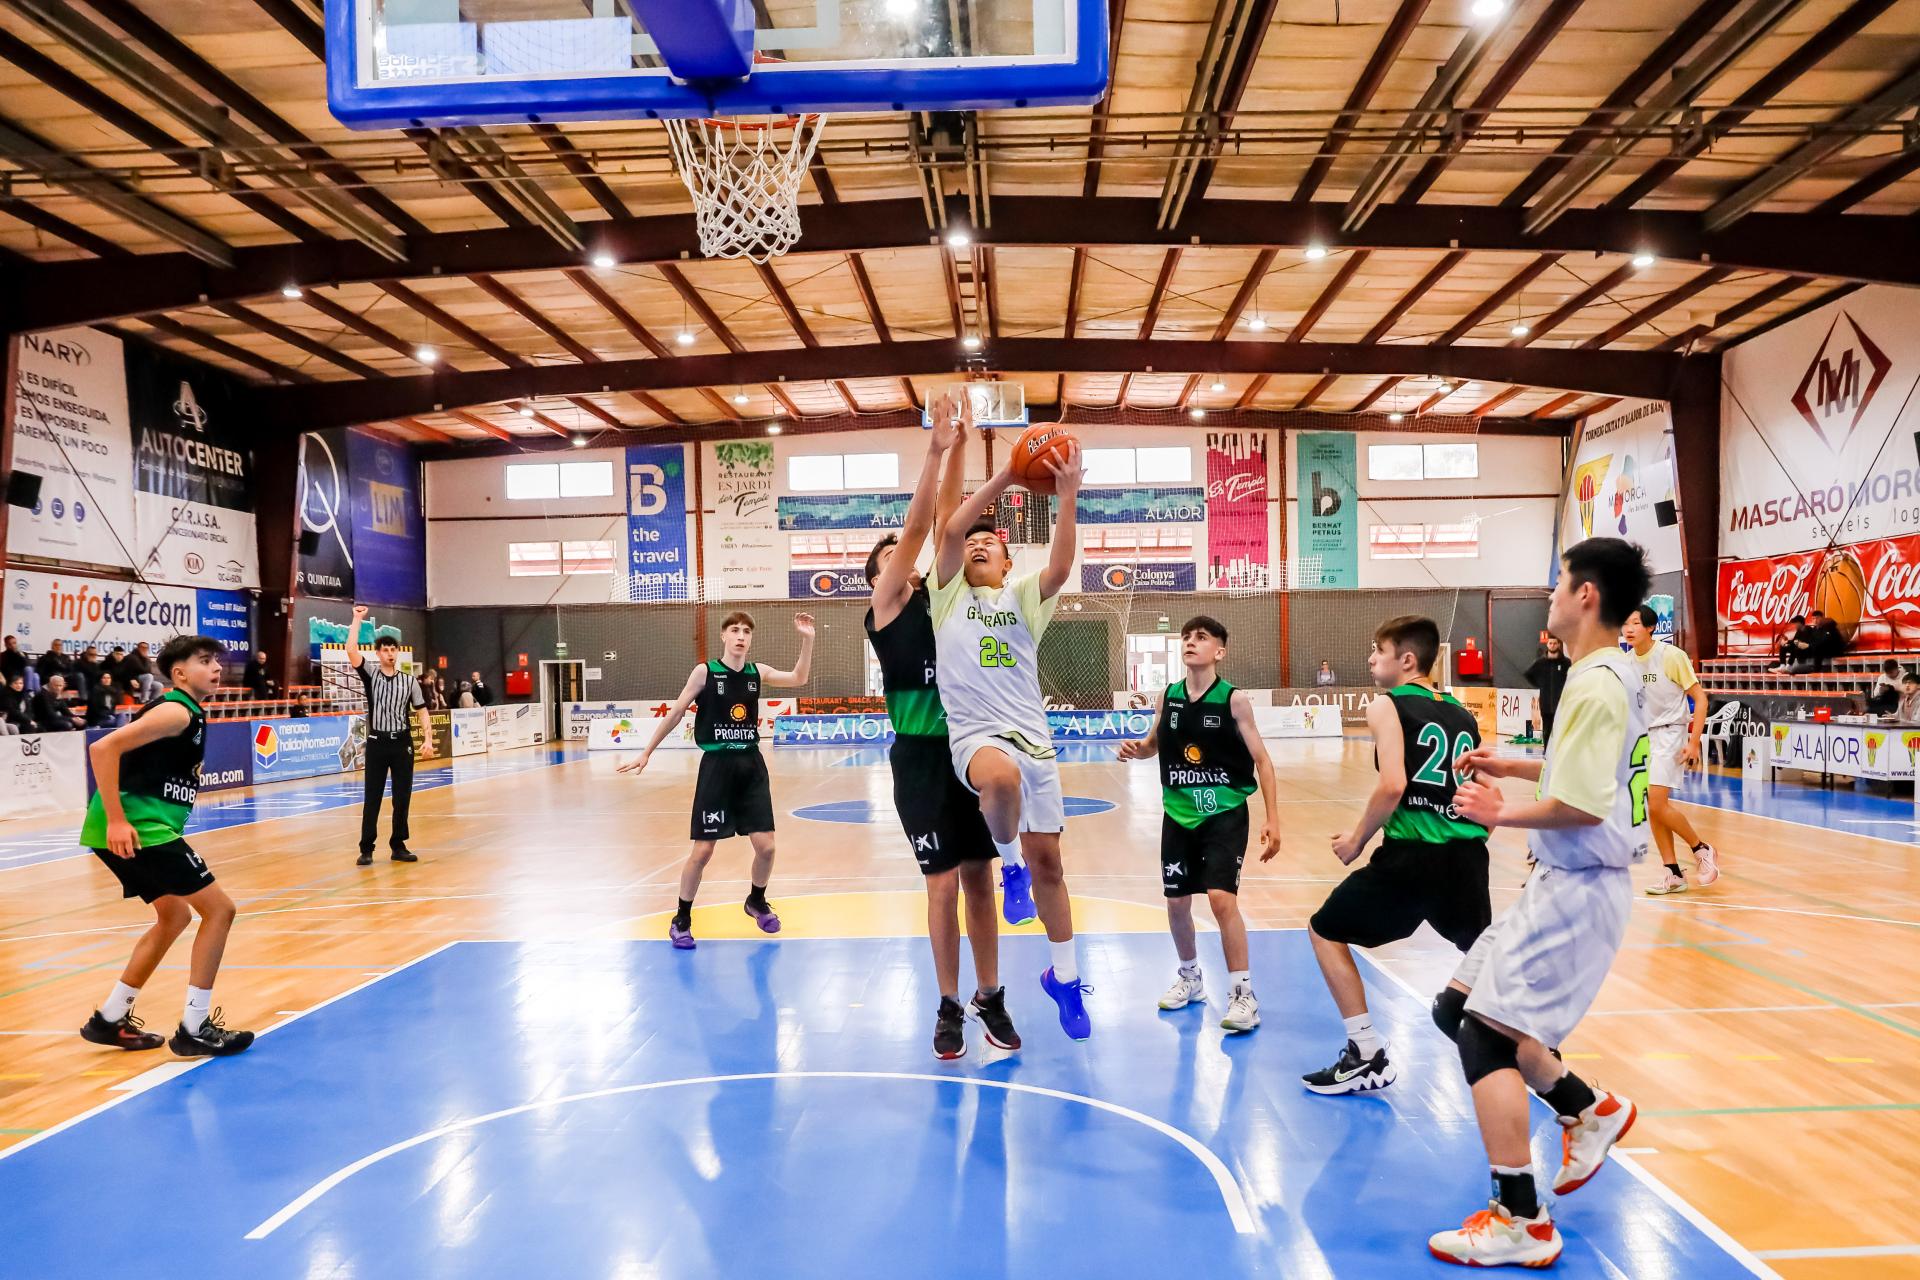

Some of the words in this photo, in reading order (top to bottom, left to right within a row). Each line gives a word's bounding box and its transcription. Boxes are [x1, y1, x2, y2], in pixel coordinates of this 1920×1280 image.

[141, 427, 244, 477] AUTOCENTER
[630, 464, 667, 516] B
[1208, 480, 1225, 498] Es
[1224, 472, 1266, 502] Temple
[1145, 505, 1201, 520] ALAIOR
[1730, 478, 1844, 532] MASCARÓ
[870, 512, 907, 526] ALAI
[1812, 514, 1870, 540] serveis
[632, 527, 660, 542] the
[187, 558, 200, 570] KIA
[632, 547, 679, 563] travel
[634, 568, 683, 584] brand
[1133, 569, 1175, 581] Colonya
[51, 581, 191, 632] infotelecom
[1291, 693, 1381, 710] AQUITA
[1064, 714, 1156, 735] ALAIO
[1412, 722, 1474, 789] 20
[1793, 733, 1860, 765] ALAIOR
[163, 782, 197, 803] PROB
[1193, 789, 1217, 813] 13
